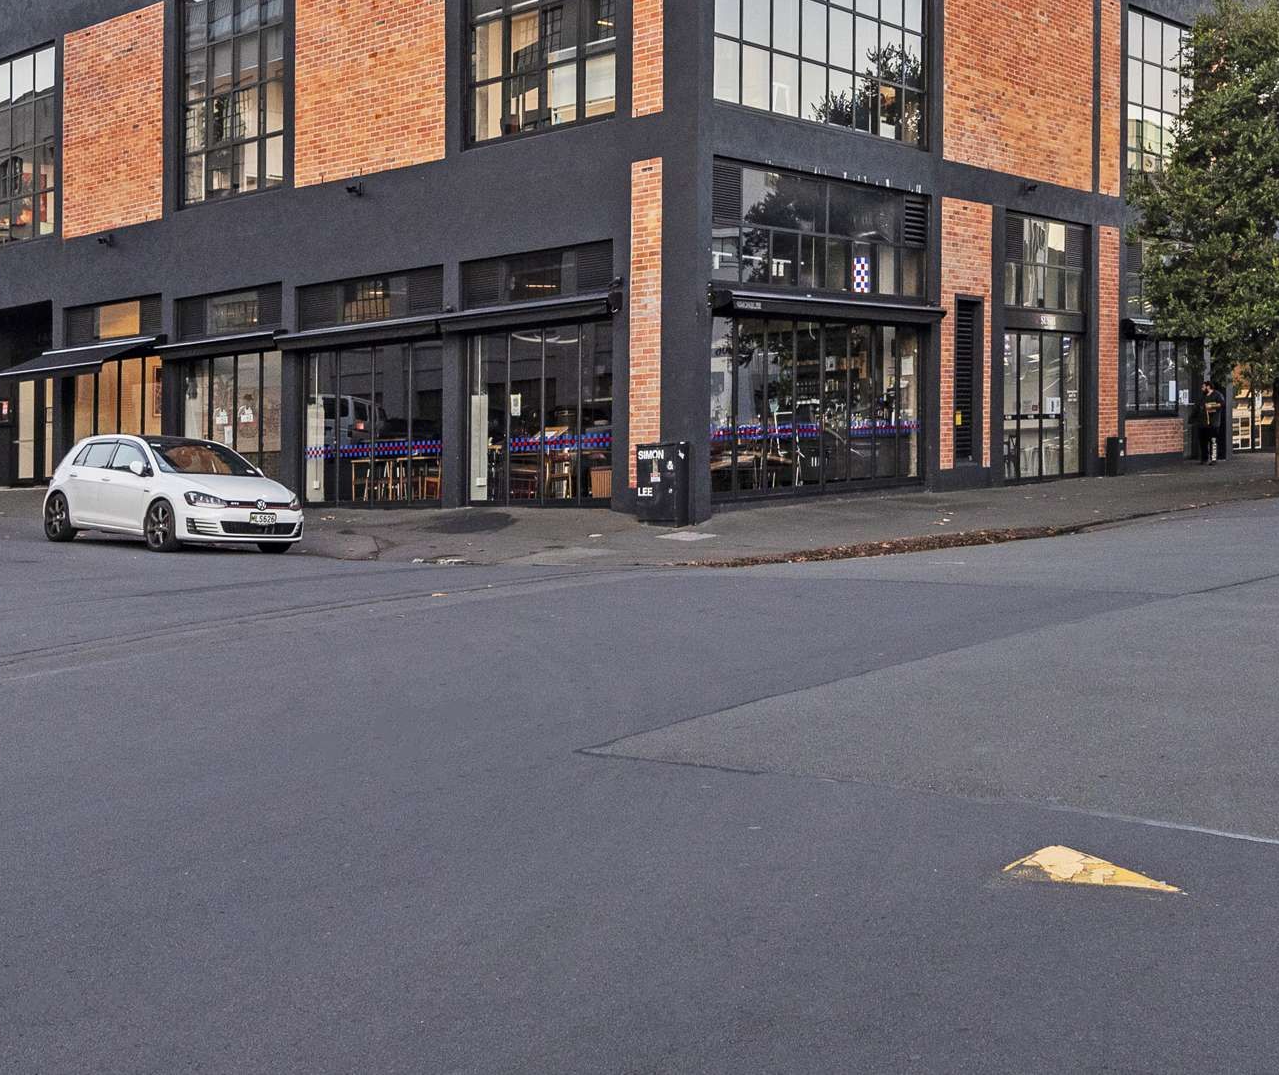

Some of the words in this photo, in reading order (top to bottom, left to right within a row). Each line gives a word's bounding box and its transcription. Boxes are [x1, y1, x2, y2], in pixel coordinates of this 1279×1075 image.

[638, 449, 664, 460] SIMON
[667, 460, 674, 471] &
[638, 487, 653, 496] LEE
